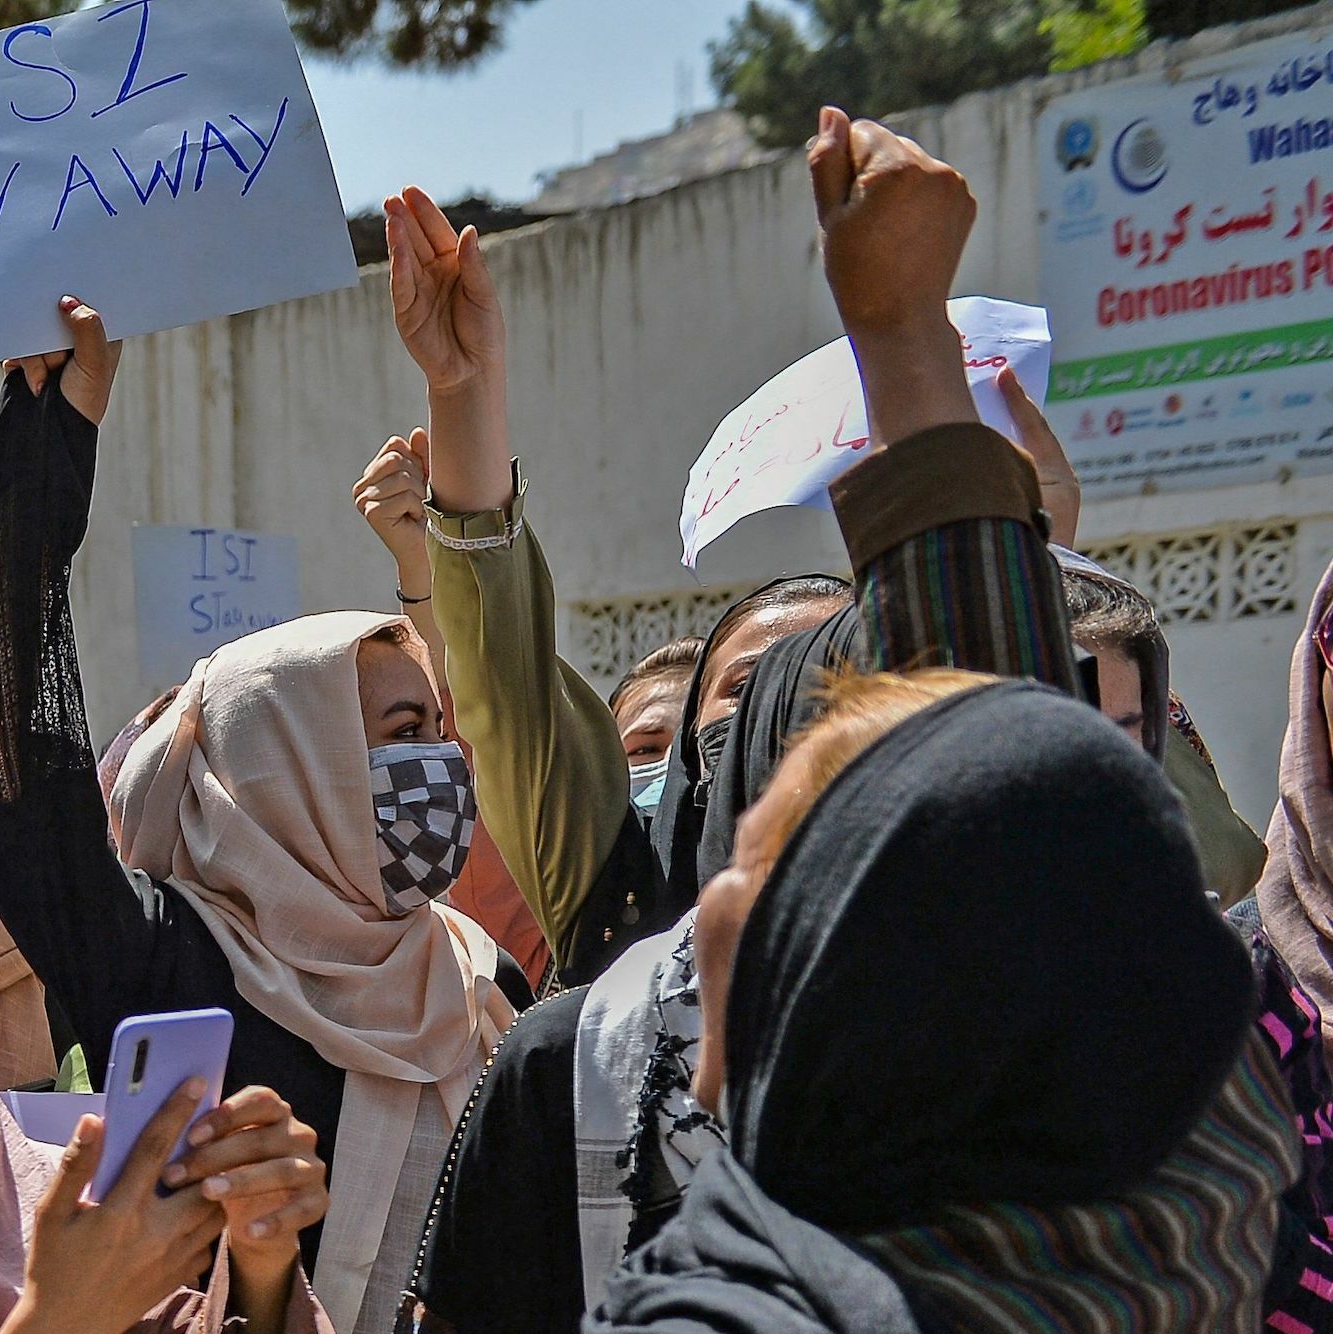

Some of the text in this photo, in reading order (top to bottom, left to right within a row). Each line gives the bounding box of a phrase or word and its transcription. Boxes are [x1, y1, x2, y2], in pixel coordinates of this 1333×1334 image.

[52, 98, 288, 231] AWAY
[1249, 117, 1333, 166] Waha
[1113, 203, 1195, 268] کرونا
[1203, 186, 1276, 240] تست
[1098, 257, 1296, 328] Coronavirus
[190, 529, 258, 581] ISI
